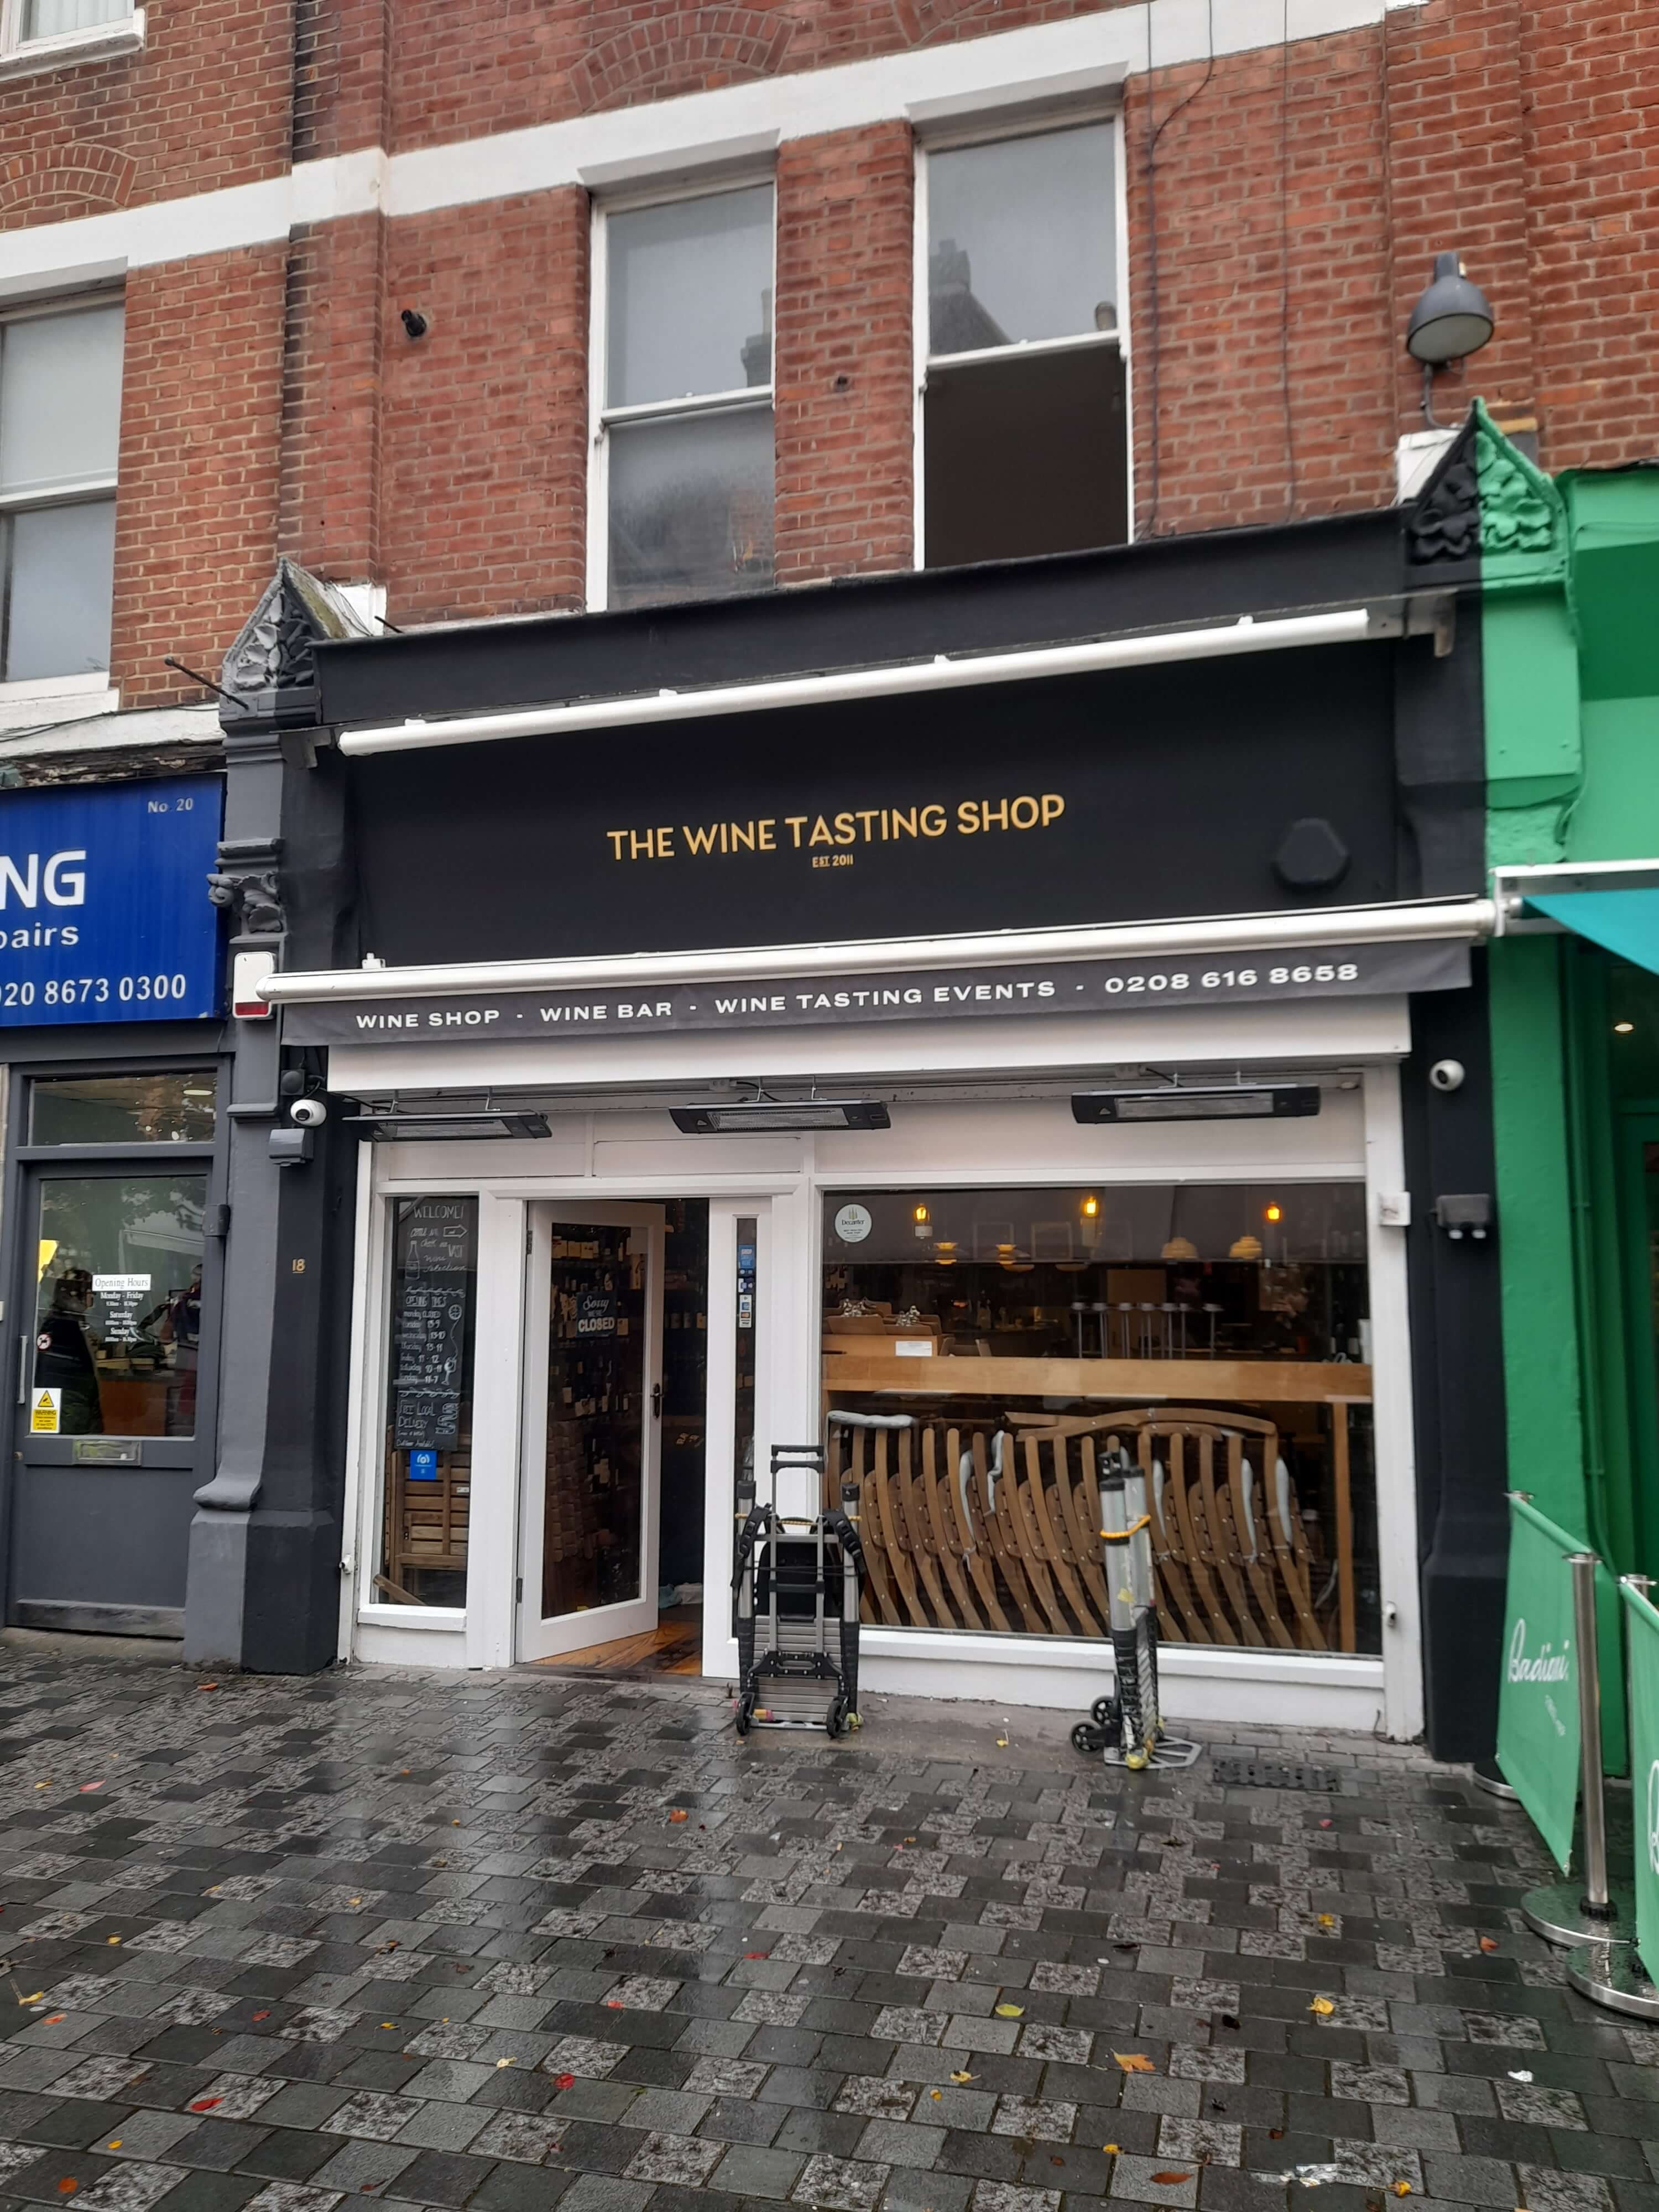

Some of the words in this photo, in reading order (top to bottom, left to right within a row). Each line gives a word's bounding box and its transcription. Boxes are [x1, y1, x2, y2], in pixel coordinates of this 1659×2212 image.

[176, 797, 194, 811] 20
[607, 826, 675, 860] THE
[682, 819, 776, 855] WINE
[785, 805, 948, 848] TASTING
[957, 794, 1065, 835] SHOP
[812, 856, 830, 868] EST
[832, 854, 853, 866] 2011
[44, 978, 109, 1005] 8673
[119, 973, 186, 1001] 0300
[356, 1013, 419, 1029] WINE
[429, 1010, 499, 1027] SHOP
[540, 1005, 607, 1022] WINE
[617, 1002, 672, 1019] BAR
[715, 996, 787, 1014] WINE
[796, 988, 922, 1010] TASTING
[933, 980, 1055, 1003] EVENTS
[1105, 973, 1190, 993] 0208
[1201, 969, 1258, 988] 616
[1268, 963, 1359, 984] 8658
[293, 1258, 305, 1274] 18
[95, 1278, 124, 1289] Opening
[127, 1277, 149, 1286] Hours
[583, 1295, 609, 1313] Sorry
[578, 1317, 614, 1332] CLOSED
